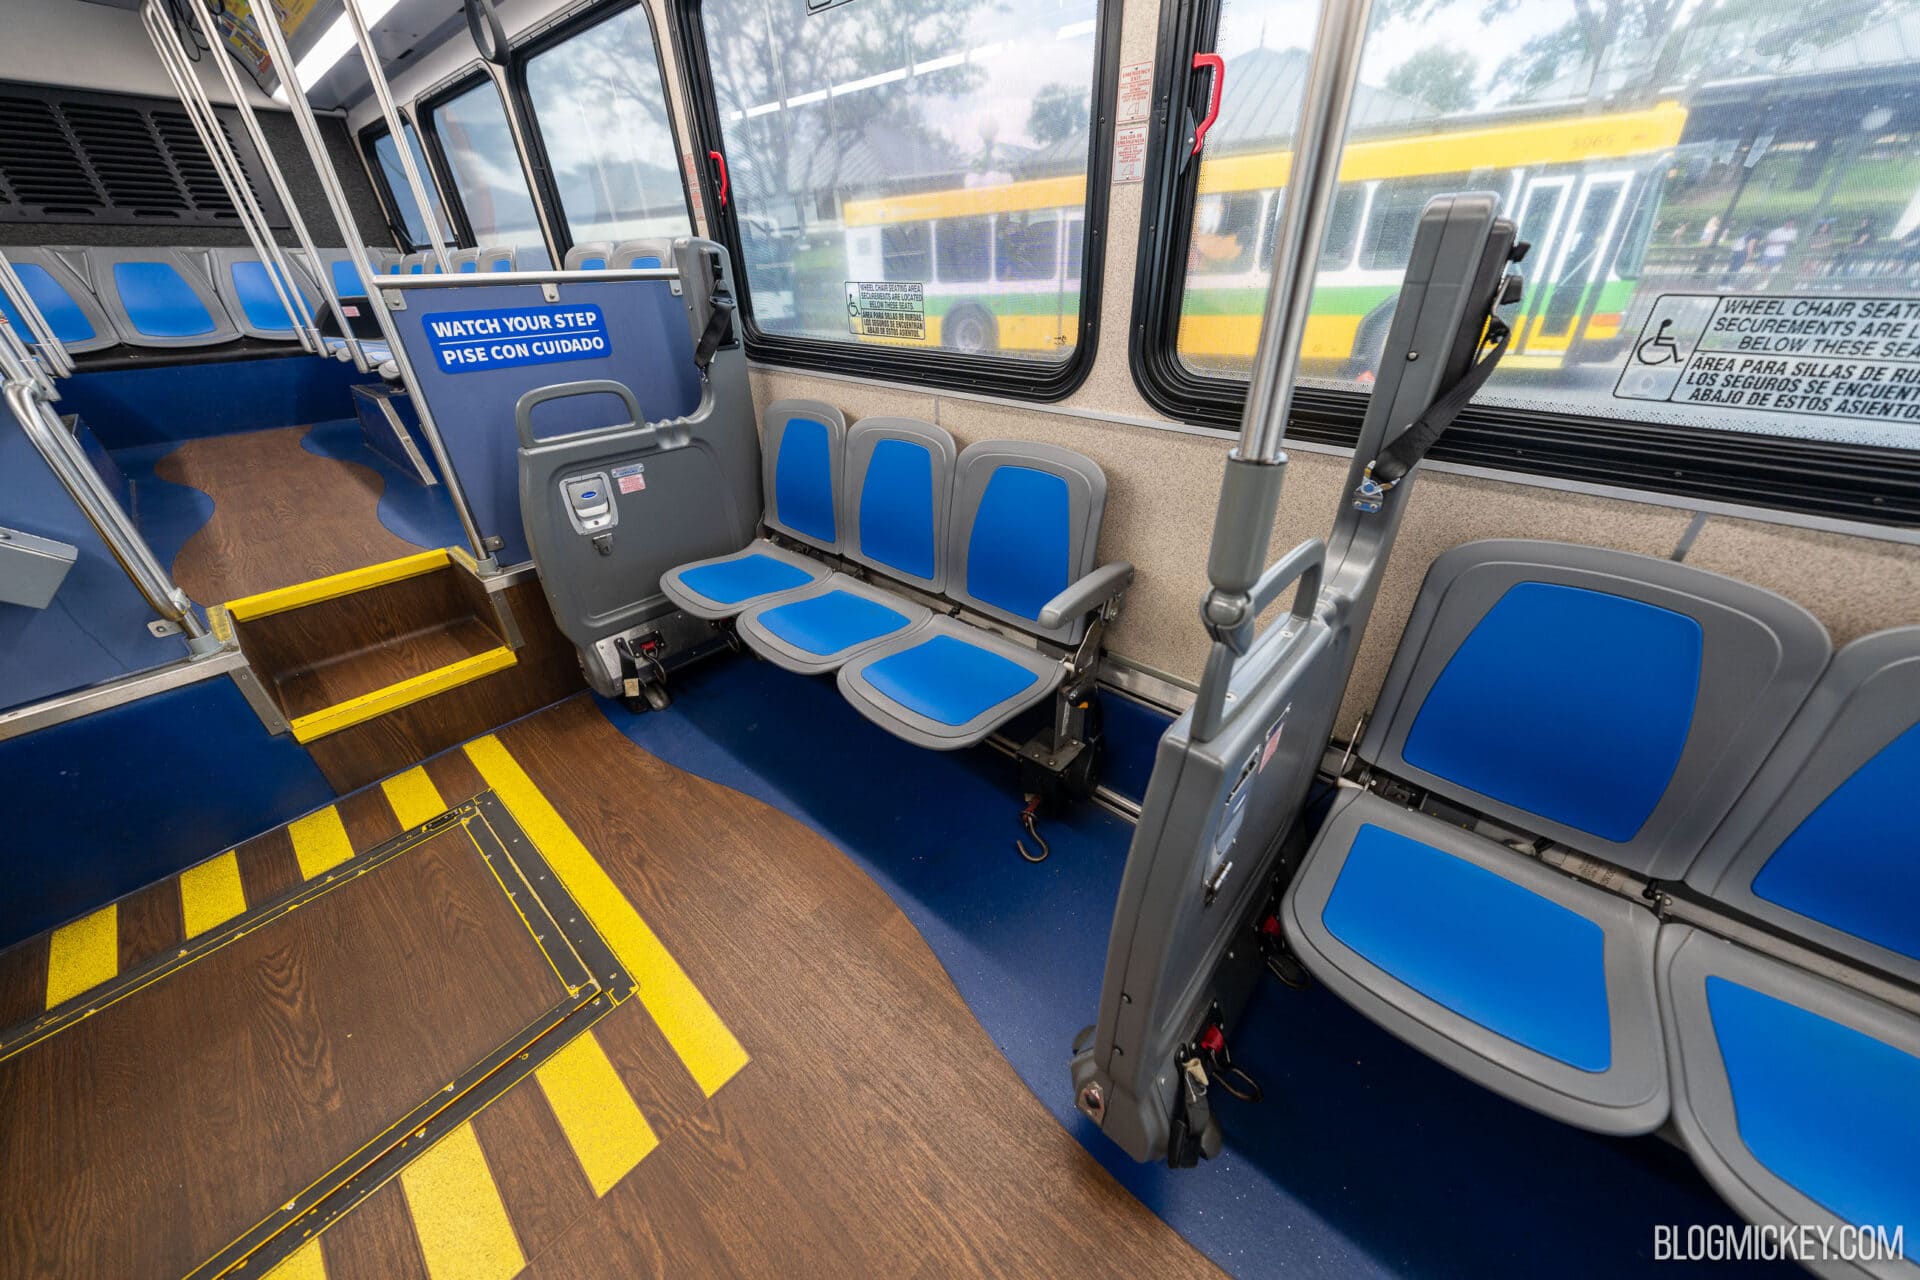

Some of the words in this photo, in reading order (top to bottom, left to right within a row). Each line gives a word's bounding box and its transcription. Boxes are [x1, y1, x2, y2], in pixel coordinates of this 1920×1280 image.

[1724, 299, 1785, 316] WHEEL
[1793, 300, 1857, 317] CHAIR
[431, 318, 502, 338] WATCH
[502, 314, 552, 333] YOUR
[554, 311, 597, 329] STEP
[1713, 316, 1857, 337] SECUREMENTS
[1858, 321, 1906, 338] ARE
[442, 347, 489, 366] PISE
[490, 343, 530, 360] CON
[532, 336, 605, 356] CUIDADO
[1738, 335, 1809, 352] BELOW
[1812, 339, 1879, 356] THESE
[1686, 372, 1719, 387] LOS
[1721, 374, 1803, 393] SEGUROS
[1804, 379, 1831, 395] SE
[1739, 359, 1788, 376] PARA
[1791, 361, 1858, 380] SILLAS
[1859, 366, 1890, 381] DE
[1889, 368, 1920, 384] RU
[1688, 387, 1745, 405] ABAJO
[1746, 391, 1773, 407] DE
[1774, 394, 1833, 412] ESTOS
[1834, 398, 1920, 419] ASIENTO
